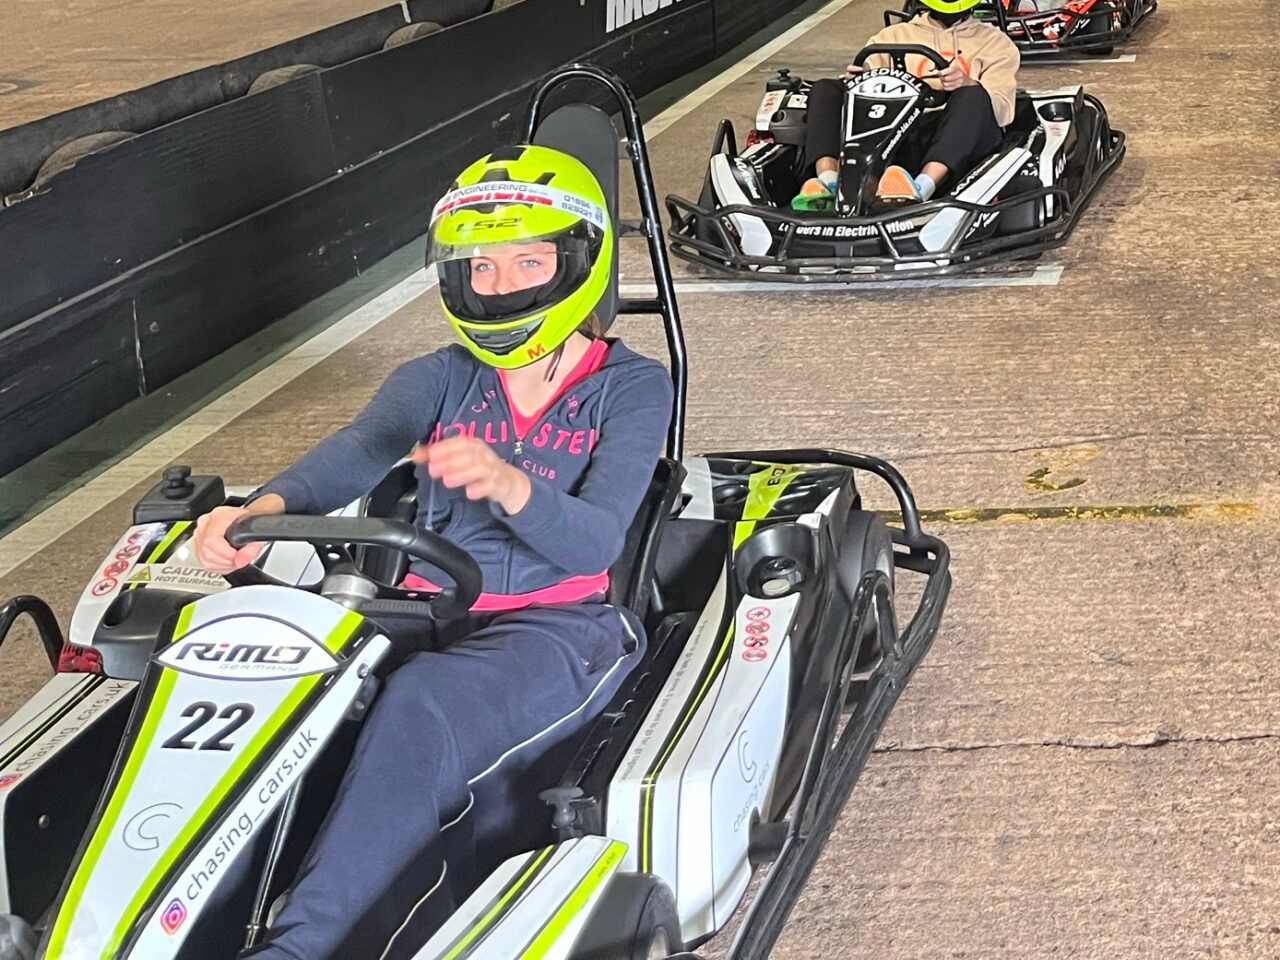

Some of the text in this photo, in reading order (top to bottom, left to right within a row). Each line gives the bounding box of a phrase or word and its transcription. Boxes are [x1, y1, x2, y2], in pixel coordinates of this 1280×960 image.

[847, 68, 923, 92] SPEEDWELL
[868, 104, 887, 119] 3
[526, 342, 547, 360] M
[522, 458, 557, 480] CLUB
[154, 575, 226, 588] HOT SURFACE
[160, 700, 256, 752] 22
[186, 727, 318, 901] chasing_cars.uk
